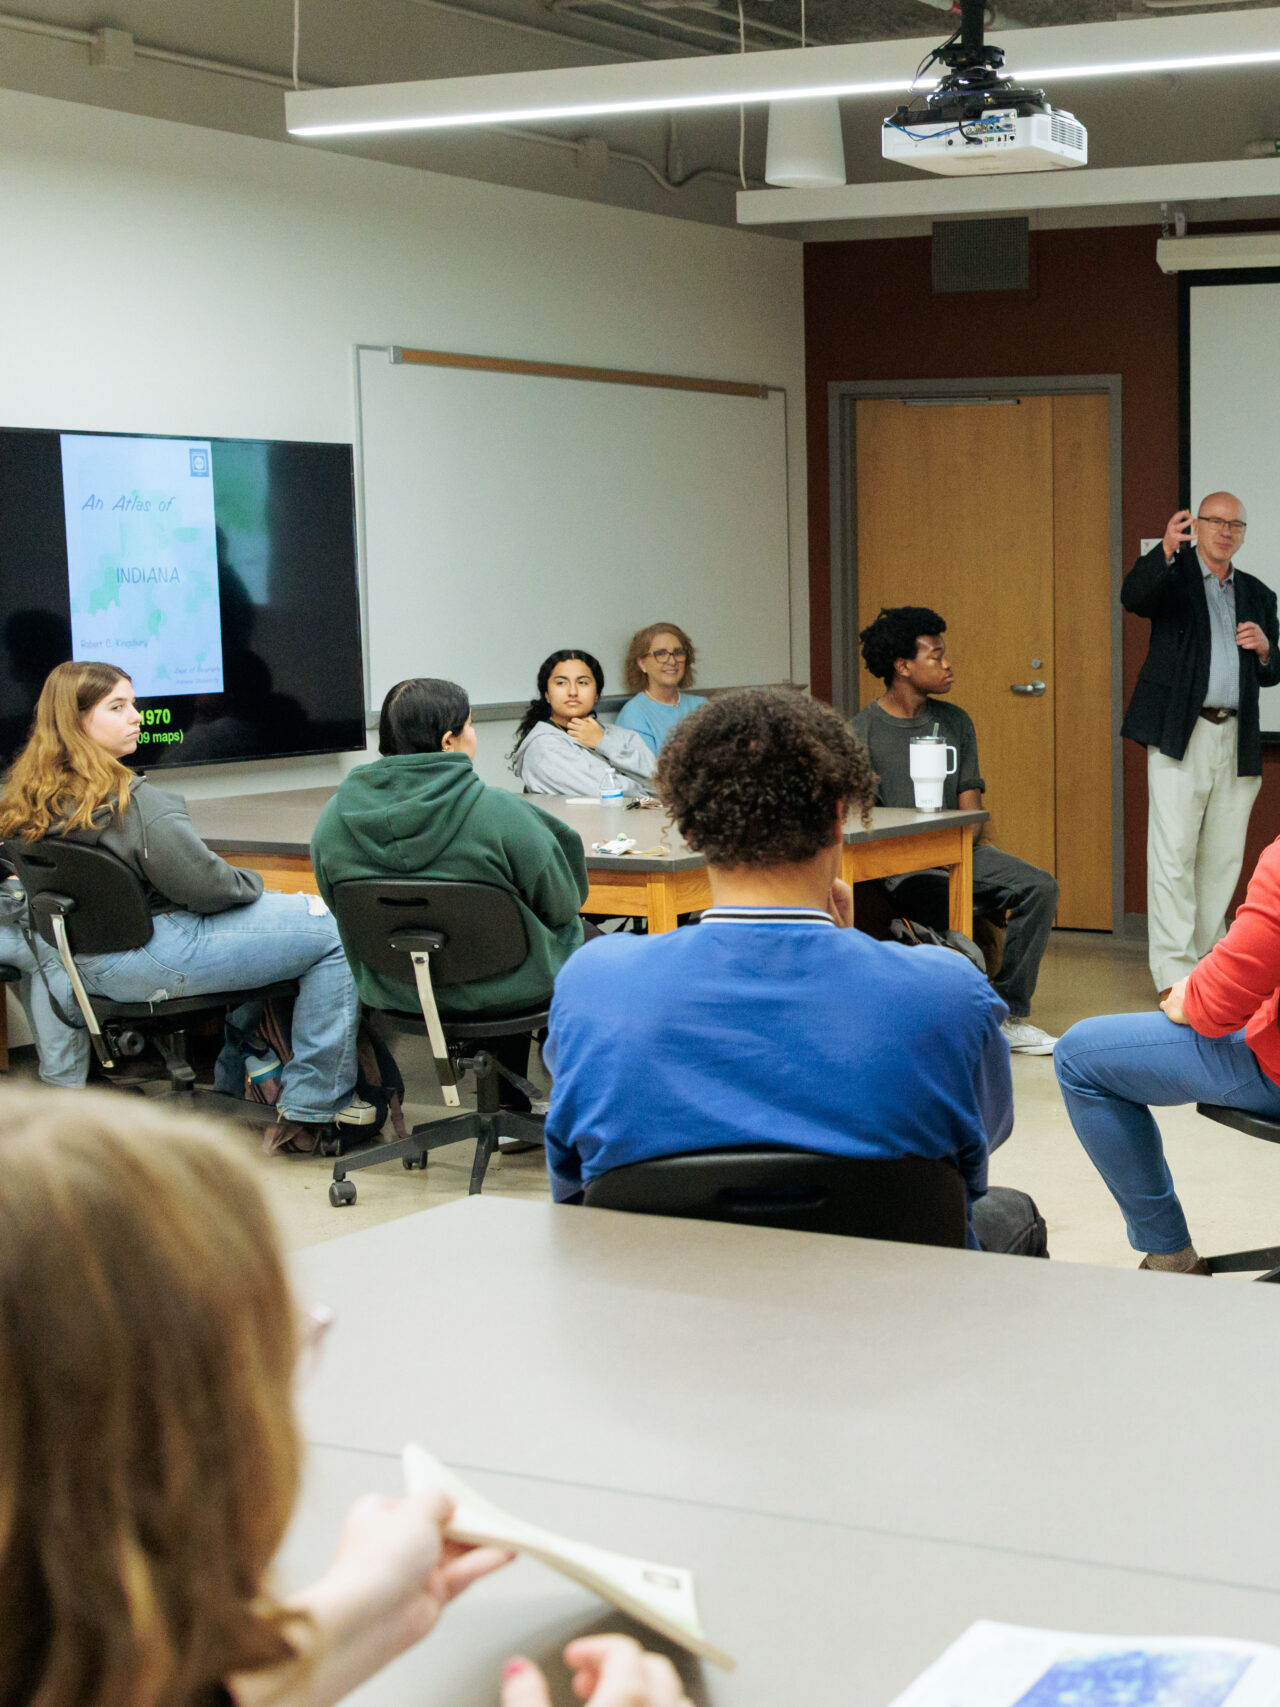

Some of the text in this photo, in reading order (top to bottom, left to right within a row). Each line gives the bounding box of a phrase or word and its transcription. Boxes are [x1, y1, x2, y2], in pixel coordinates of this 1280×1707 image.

[81, 492, 177, 513] An Atlas of
[116, 566, 181, 585] INDIANA
[138, 707, 172, 726] 1970
[152, 728, 185, 746] maps)
